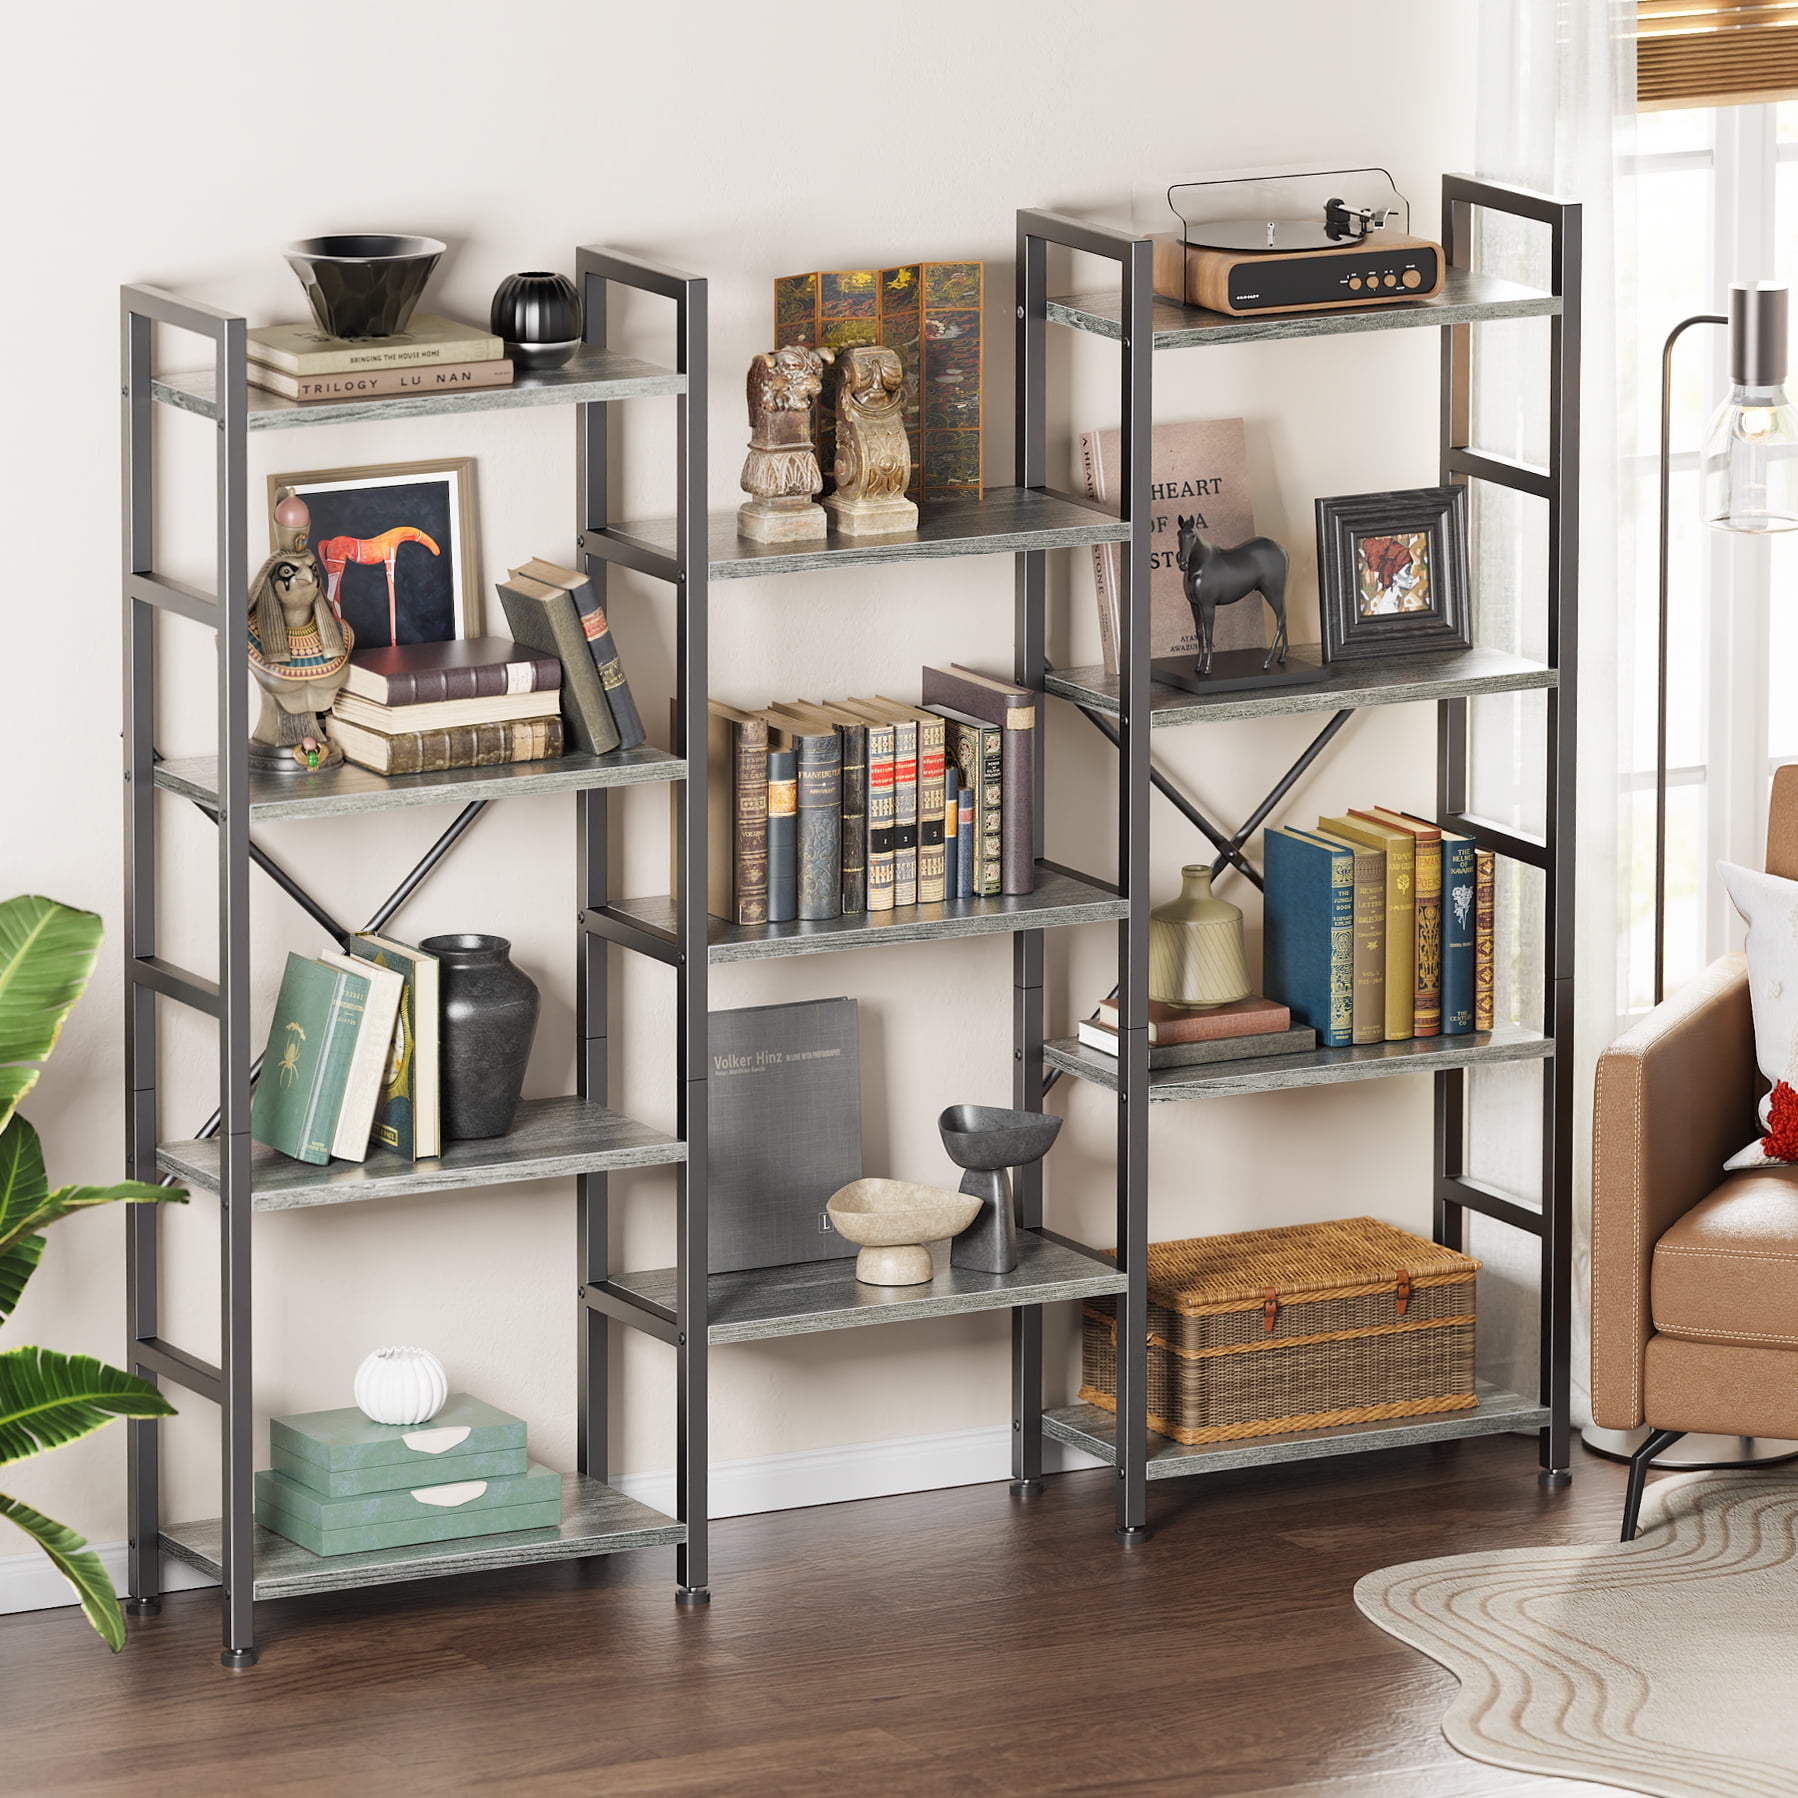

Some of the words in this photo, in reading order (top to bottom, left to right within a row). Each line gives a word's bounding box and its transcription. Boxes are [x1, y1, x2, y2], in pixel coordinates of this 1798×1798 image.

[350, 355, 382, 364] BRINGING
[384, 353, 397, 361] THE
[399, 351, 420, 360] HOUSE
[422, 350, 440, 358] HOME
[303, 379, 378, 394] TRILOGY
[400, 376, 421, 386] LU
[436, 371, 472, 383] NAN
[1152, 478, 1222, 500] HEART
[1151, 516, 1168, 533] F
[1151, 551, 1181, 570] ST
[714, 1053, 752, 1070] Volker
[756, 1050, 783, 1065] Hinz
